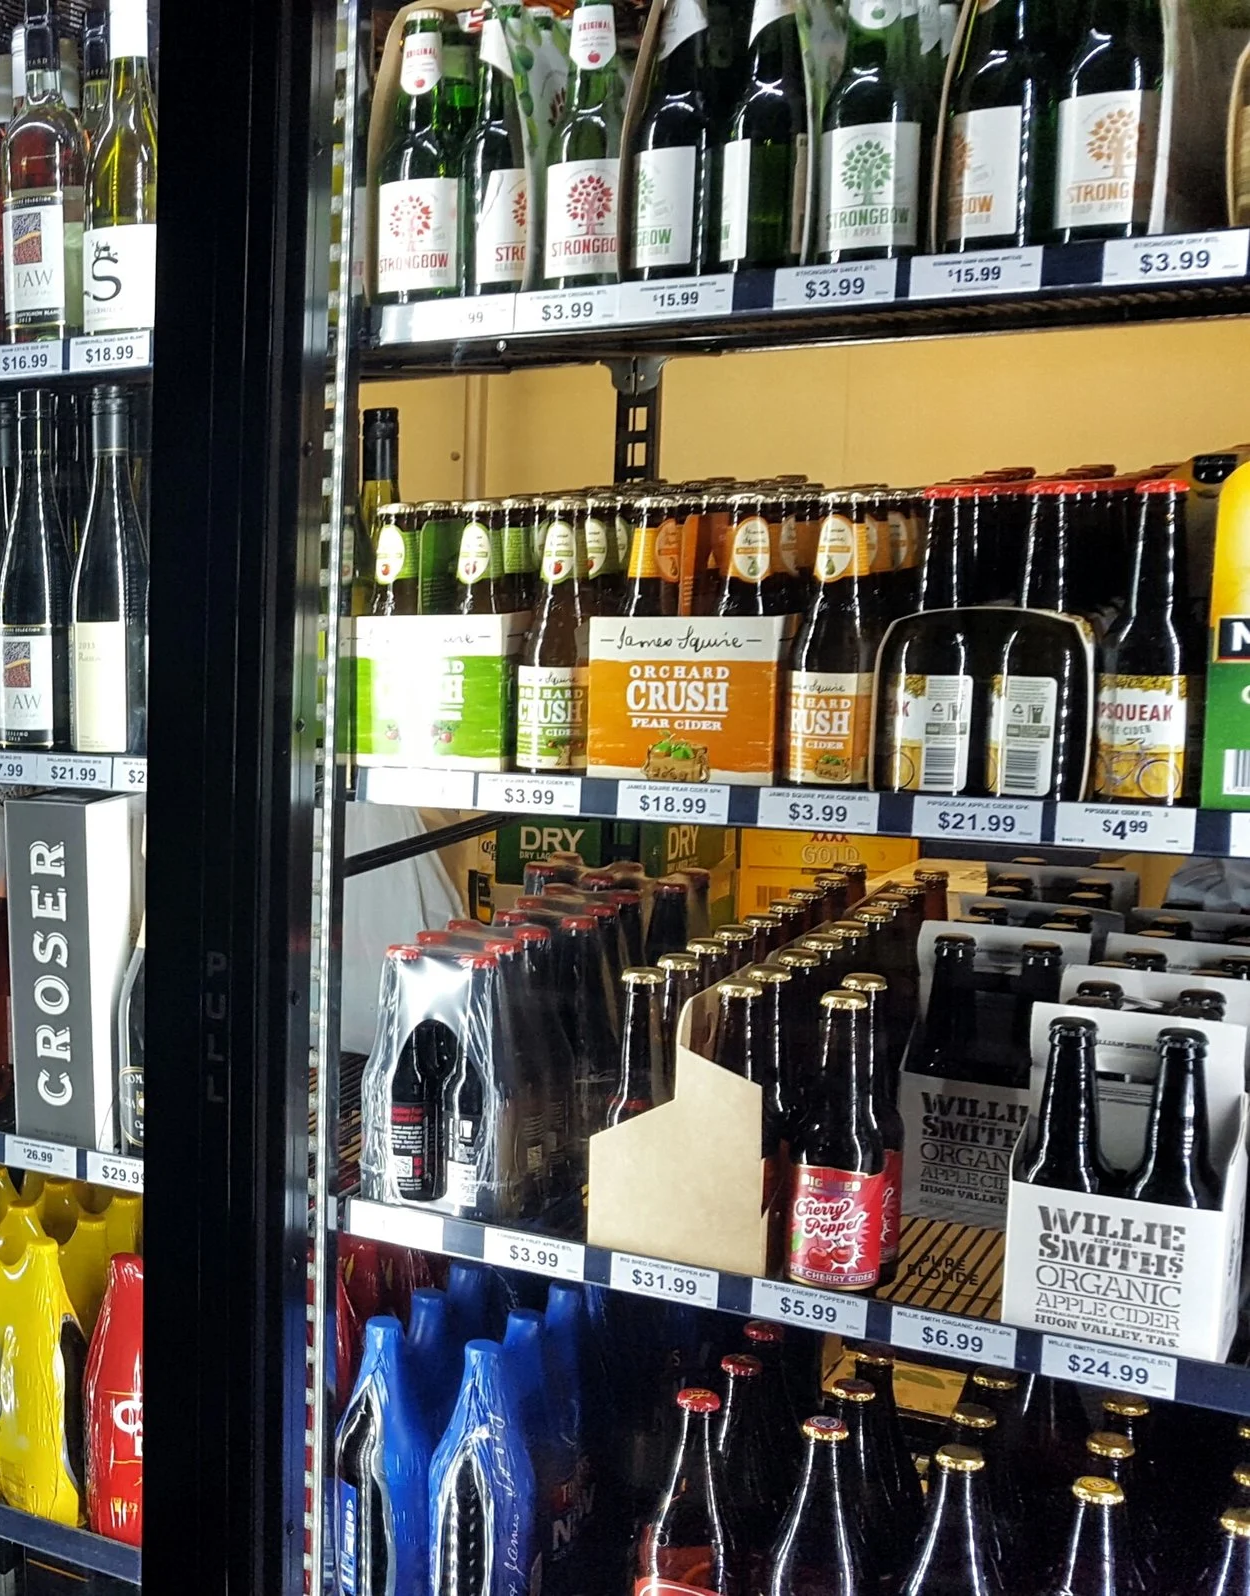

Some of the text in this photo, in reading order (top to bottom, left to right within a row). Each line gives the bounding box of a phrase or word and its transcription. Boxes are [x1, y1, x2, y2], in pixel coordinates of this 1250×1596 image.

[1068, 179, 1129, 204] STRONG
[826, 207, 910, 230] STRONGBOW
[551, 236, 617, 257] STRONGBO
[1139, 249, 1211, 275] $3.99
[948, 266, 1001, 285] $15.99
[653, 291, 699, 308] $15.99
[805, 277, 866, 300] $3.99
[541, 301, 594, 322] $3.99
[3, 354, 48, 372] $16.99
[86, 345, 133, 364] $18.99
[617, 625, 743, 653] James Squire
[629, 665, 730, 679] ORCHARD
[519, 687, 584, 700] ORHARD
[626, 680, 729, 712] CRUSH
[631, 718, 722, 731] PEAR CIDER
[791, 709, 850, 735] RUSH
[51, 766, 96, 781] $21.99
[504, 788, 554, 805] $3.99
[639, 795, 706, 816] $18.99
[788, 802, 848, 823] $3.99
[938, 811, 1016, 834] $21.99
[520, 826, 584, 852] DRY
[669, 826, 698, 858] DRY
[519, 850, 534, 860] DRY
[802, 844, 859, 865] GOLD
[30, 840, 73, 1106] CROSER
[206, 951, 227, 1103] PULL
[24, 1148, 53, 1163] $26.99
[920, 1142, 1010, 1171] ORGAN
[921, 1166, 978, 1187] APPLE
[921, 1184, 954, 1196] HUON
[796, 1198, 851, 1221] Cherry
[1038, 1205, 1186, 1252] WILLIE
[509, 1245, 558, 1268] $3.99
[920, 1254, 966, 1272] PURE
[632, 1269, 697, 1296] $31.99
[805, 1269, 873, 1282] CHERRY CIDER
[908, 1265, 979, 1286] BLONDE
[1036, 1265, 1181, 1308] ORGANIC
[774, 1285, 790, 1294] SHED
[792, 1288, 818, 1300] CHERRY
[820, 1294, 846, 1306] POPPER
[780, 1297, 837, 1323] $5.99
[897, 1310, 919, 1320] WILLIE
[920, 1314, 940, 1324] SMITH
[941, 1318, 972, 1331] ORGANIC
[1035, 1292, 1181, 1331] APPLE CIDER
[921, 1326, 983, 1353] $6.99
[1034, 1313, 1180, 1348] HUON VALLEY, TAS.
[1048, 1338, 1072, 1349] WILLIE
[1073, 1342, 1095, 1353] SMITH
[1096, 1346, 1130, 1360] ORGANIC
[1067, 1354, 1149, 1385] $24.99
